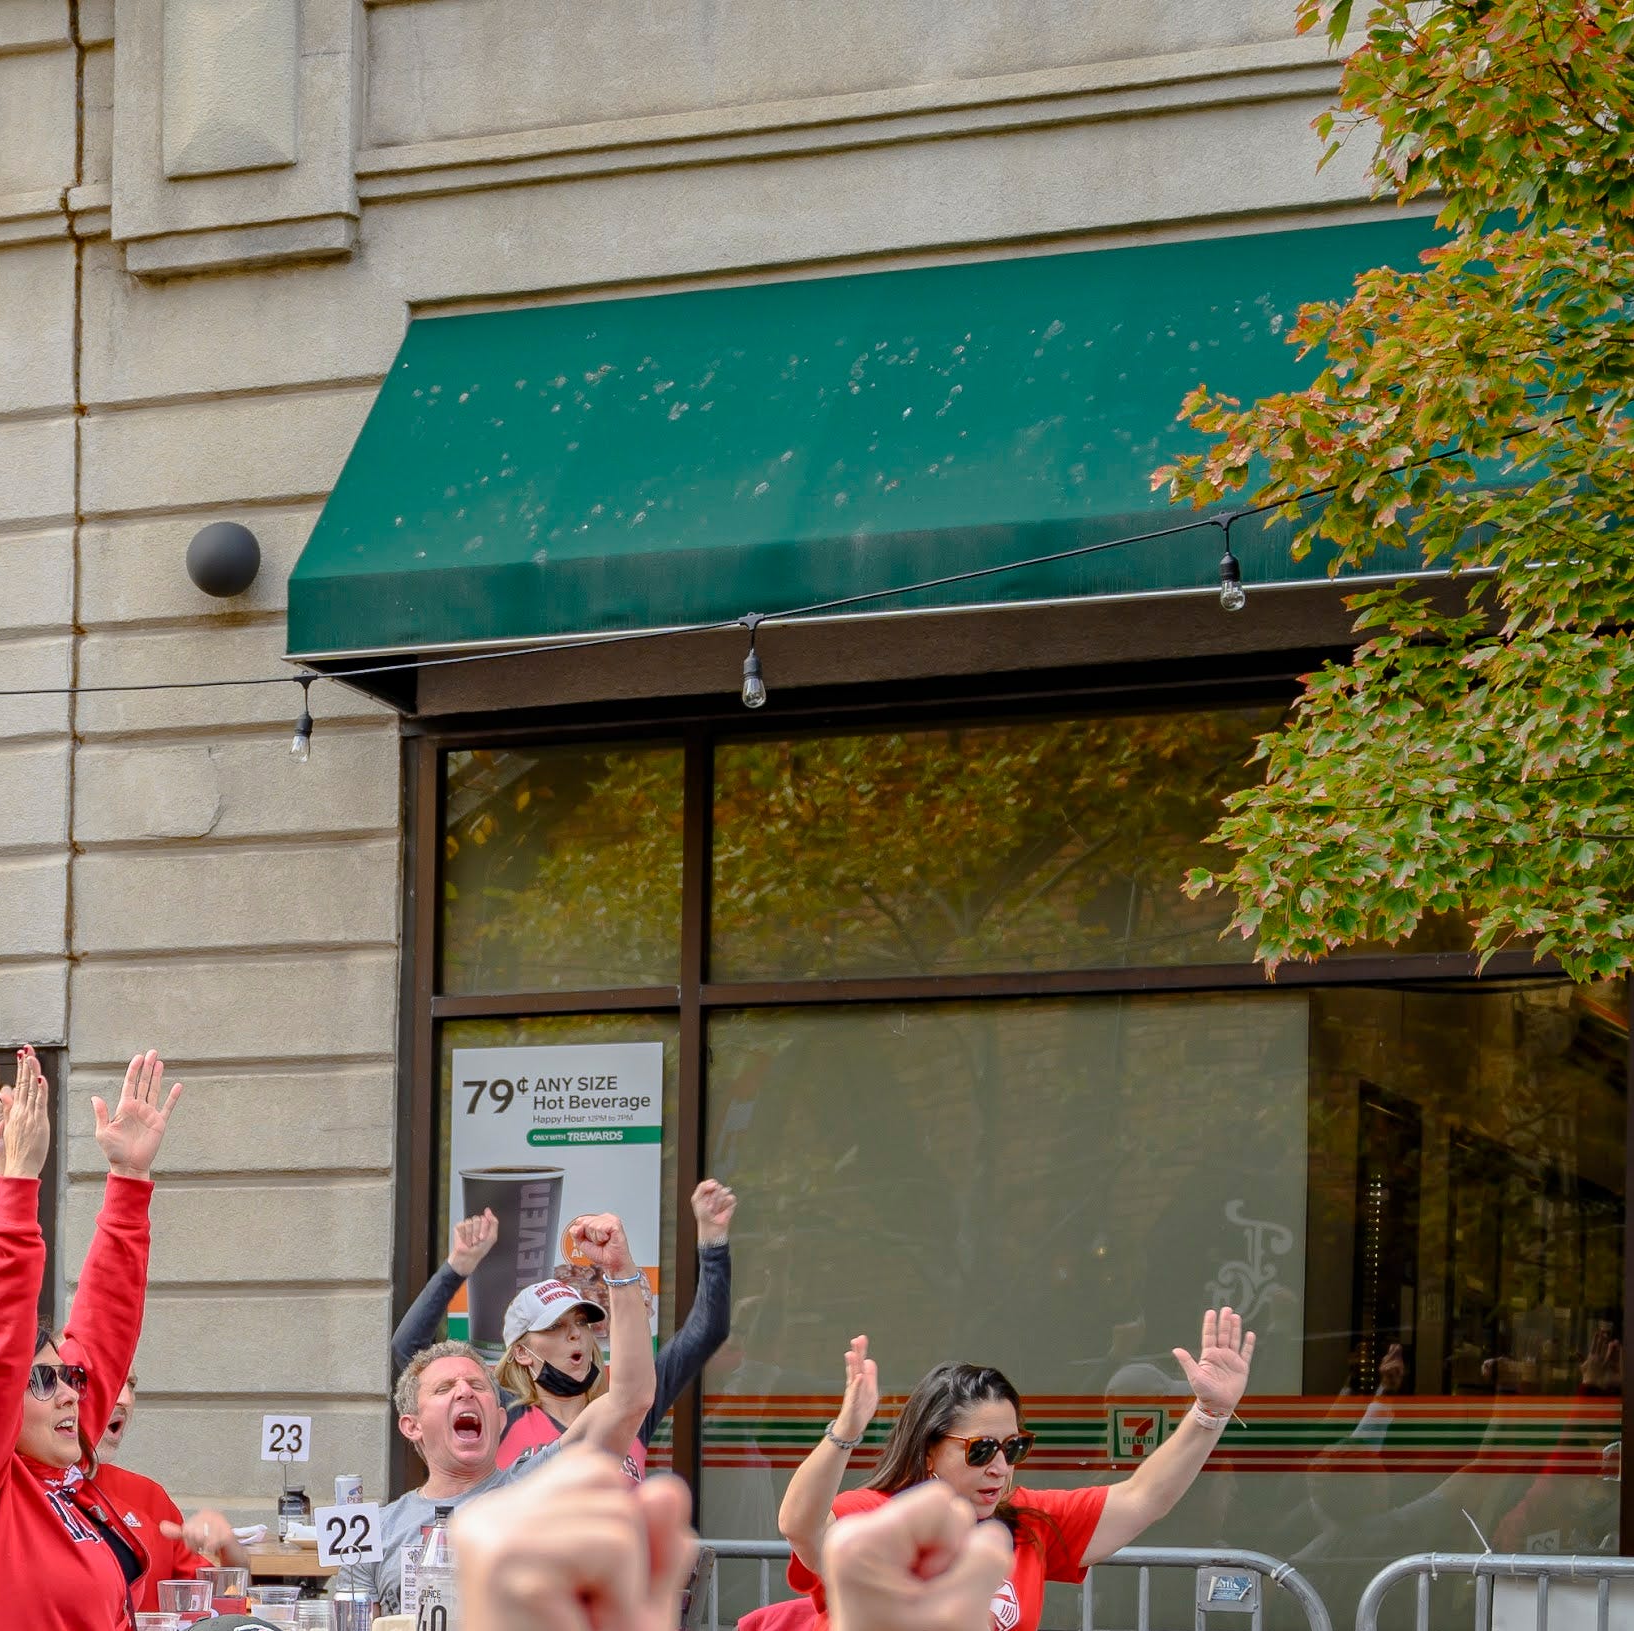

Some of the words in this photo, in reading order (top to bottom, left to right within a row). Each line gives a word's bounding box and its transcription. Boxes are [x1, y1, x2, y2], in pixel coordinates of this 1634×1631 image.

[534, 1078, 573, 1093] ANY
[577, 1076, 618, 1091] SIZE
[533, 1096, 565, 1110] Hot
[569, 1094, 651, 1111] Beverage
[533, 1115, 562, 1124] Happy
[564, 1114, 586, 1123] Hour
[567, 1130, 624, 1142] 7REWARDS
[268, 1423, 303, 1453] 23
[325, 1514, 373, 1556] 22
